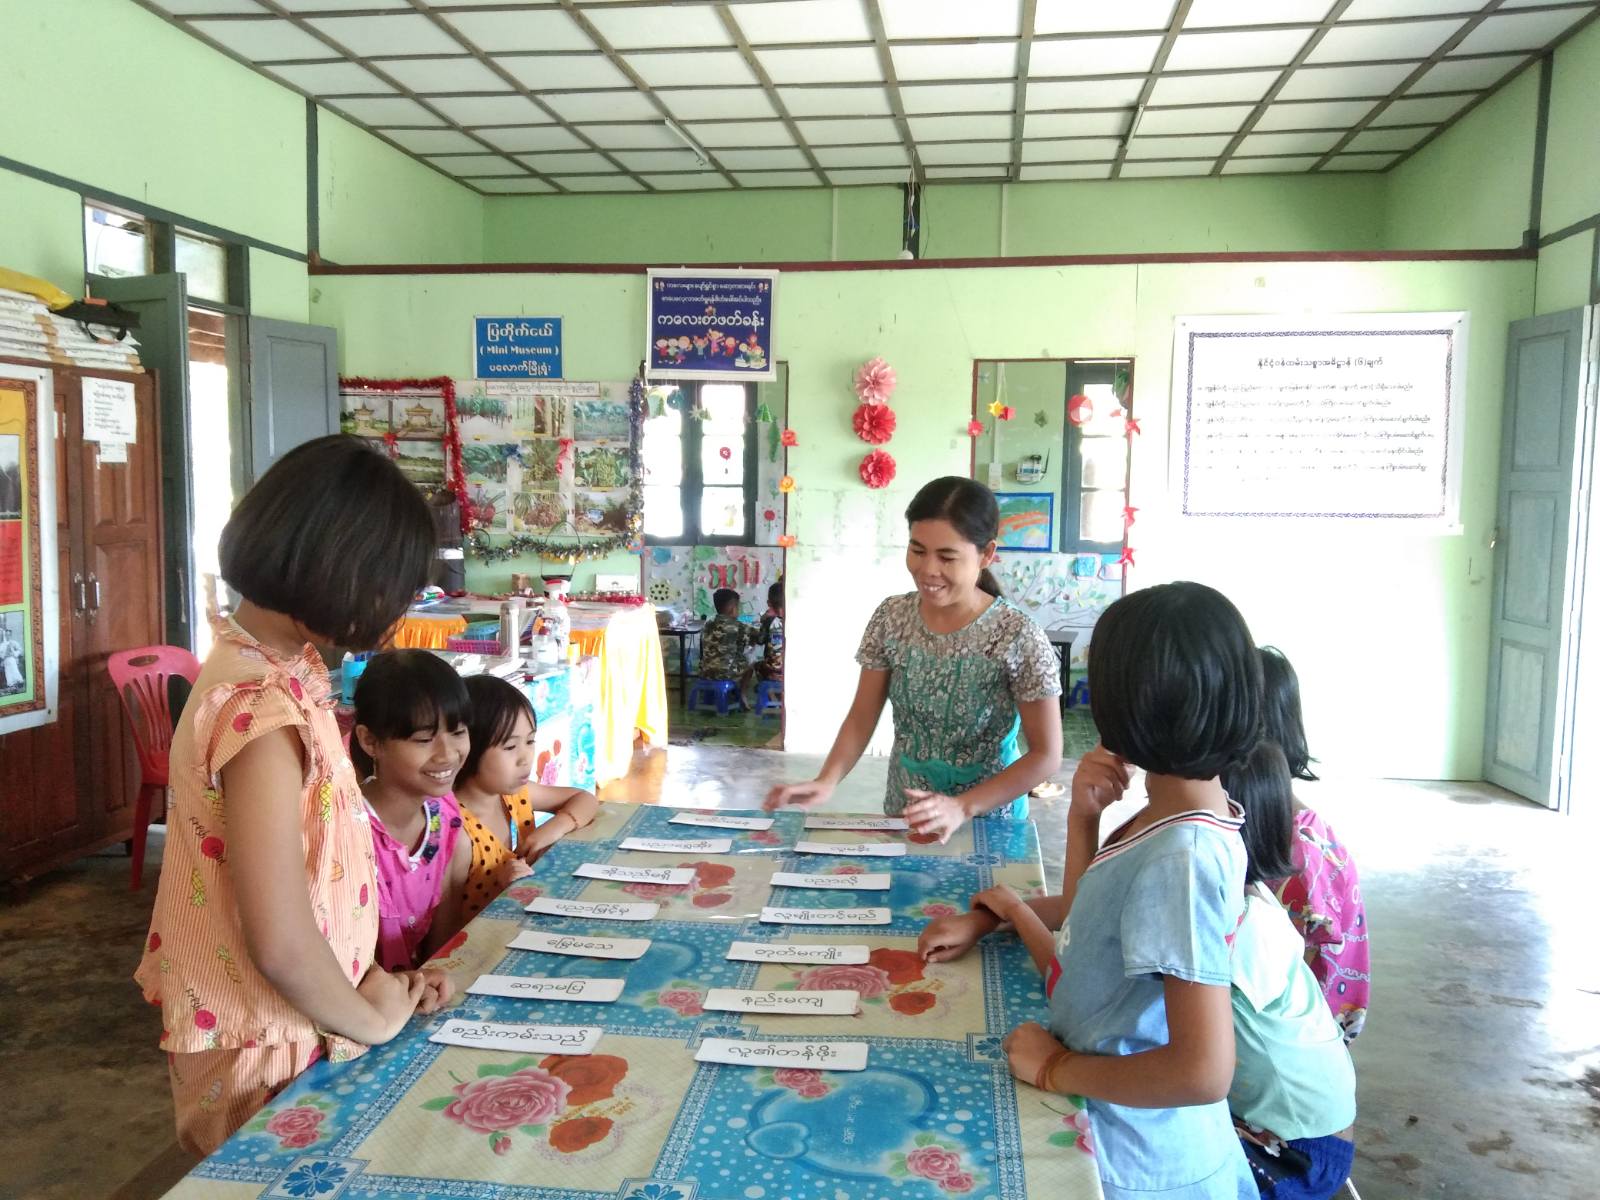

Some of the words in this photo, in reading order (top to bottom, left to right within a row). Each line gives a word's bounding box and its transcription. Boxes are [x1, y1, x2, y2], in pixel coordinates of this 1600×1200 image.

[657, 310, 765, 332] ကလေးစာဖတ်ခန်း
[487, 322, 553, 342] ပြတိုက်ငယ်
[510, 346, 552, 354] Museum
[510, 980, 586, 995] ဆရာမပြ
[741, 993, 824, 1007] နည်းမကျ
[452, 1025, 588, 1047] စည်းကမ်းသည်
[728, 1045, 837, 1061] လူ၏တန်ဖိုး
